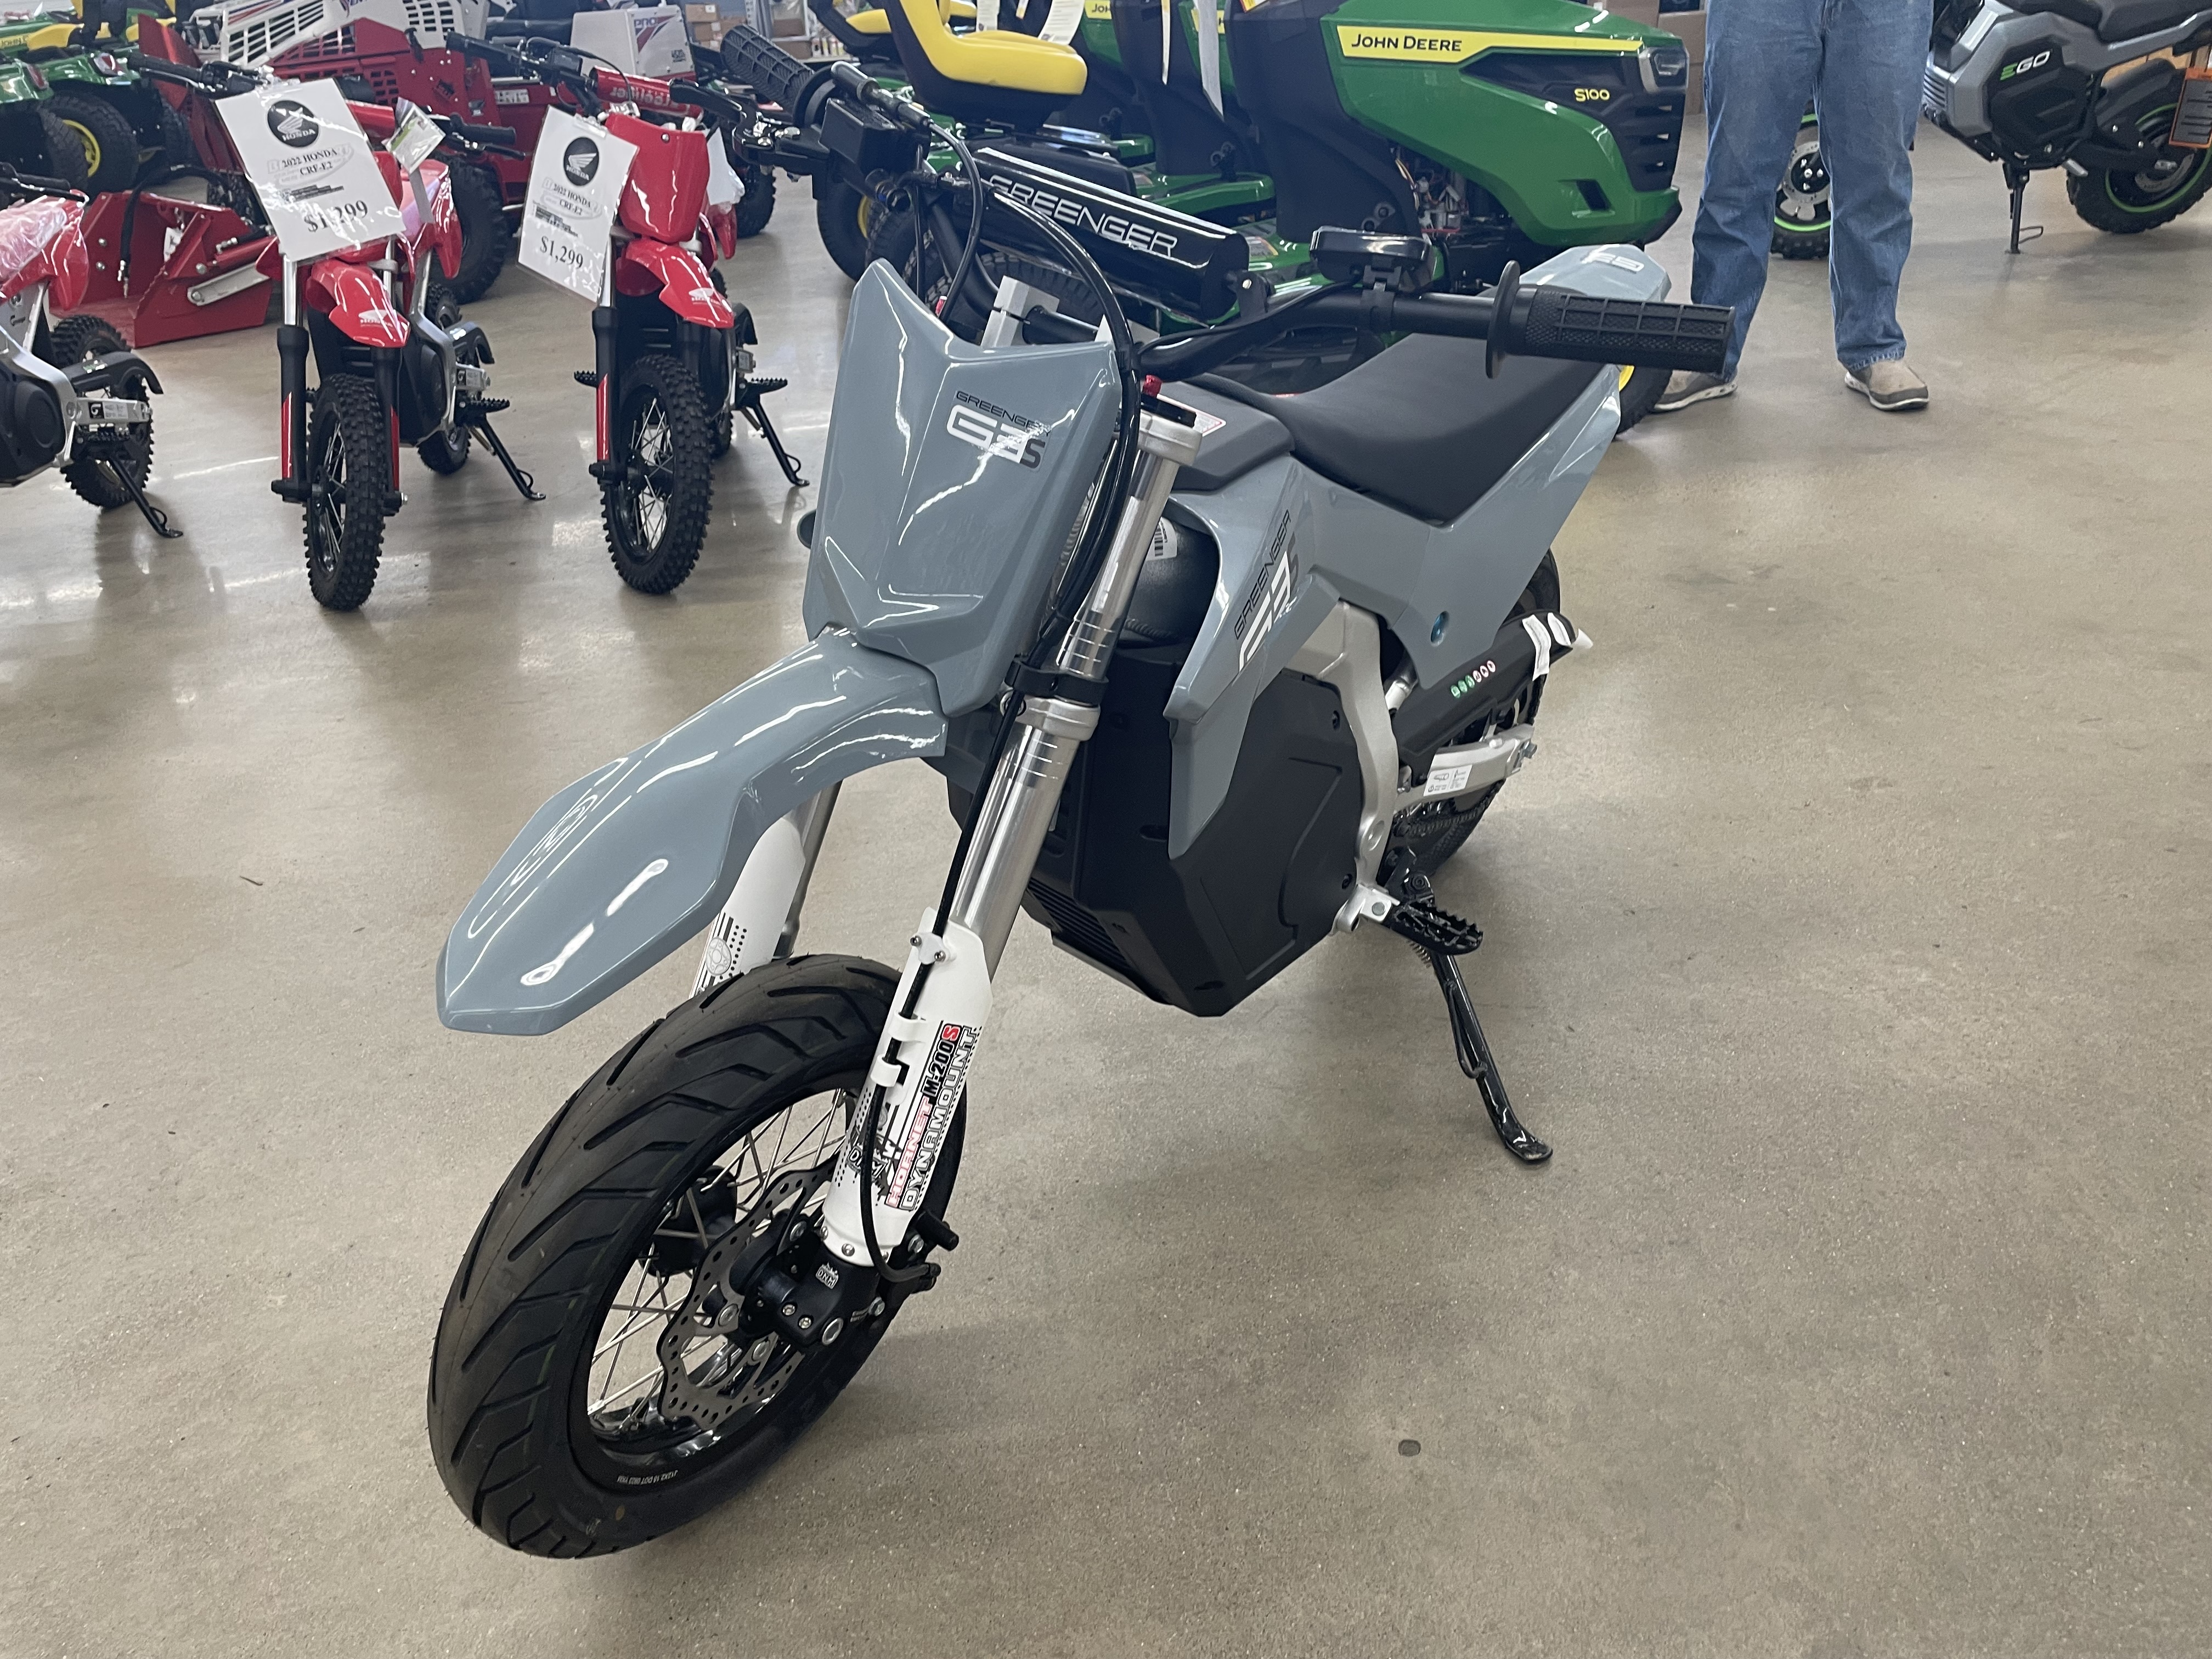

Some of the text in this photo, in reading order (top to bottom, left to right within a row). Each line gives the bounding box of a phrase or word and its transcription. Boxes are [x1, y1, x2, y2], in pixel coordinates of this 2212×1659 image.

[1351, 33, 1462, 52] JOHN DEERE
[2000, 51, 2050, 81] EGO
[1574, 88, 1610, 102] S100
[281, 129, 315, 142] HONDA
[281, 148, 337, 168] 2022 HONDA
[300, 161, 333, 176] CRF-E2
[566, 164, 590, 180] HONDA
[553, 183, 591, 208] 2022 HONDA
[989, 174, 1178, 258] GREENGER
[540, 235, 583, 269] $1,299
[1234, 509, 1291, 640] GREENGER
[900, 1025, 977, 1212] DYNAMOUNT
[886, 1096, 933, 1208] HORNET
[817, 1268, 837, 1288] DNM
